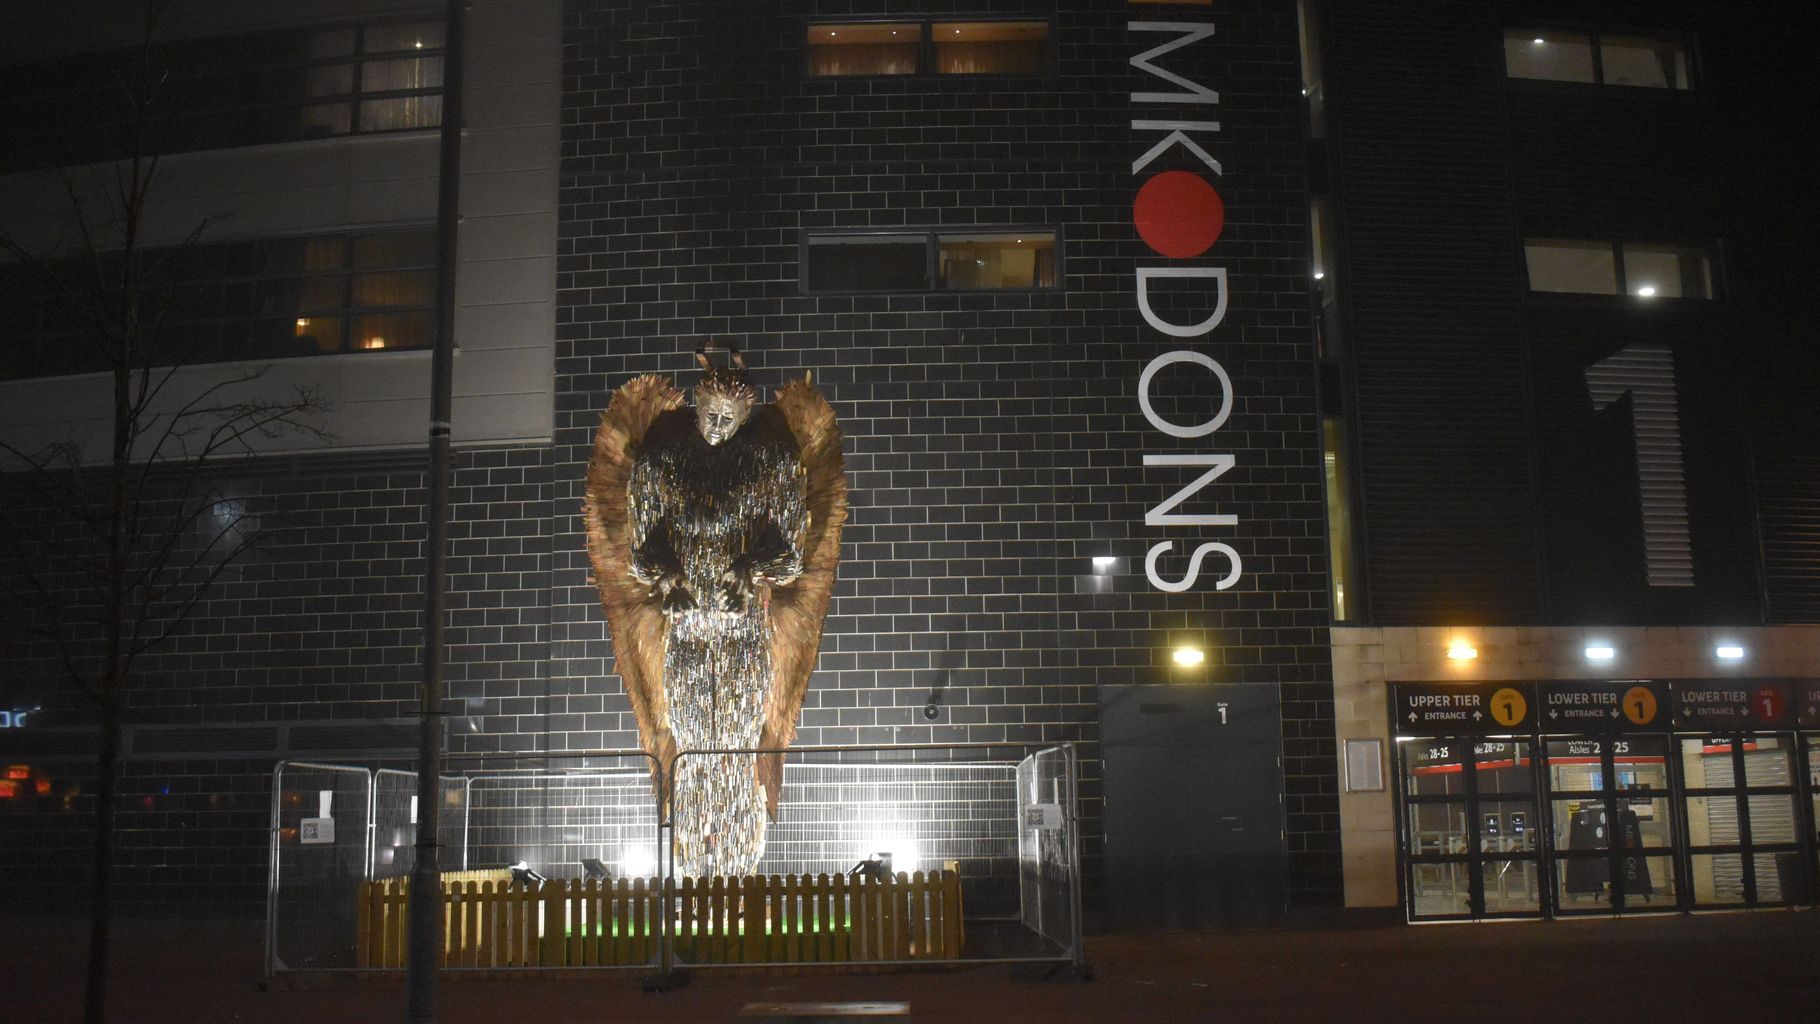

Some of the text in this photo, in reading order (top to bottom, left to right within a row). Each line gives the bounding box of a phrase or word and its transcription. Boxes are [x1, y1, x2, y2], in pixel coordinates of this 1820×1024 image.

[1127, 21, 1243, 593] MK DONS
[1583, 343, 1696, 587] 1
[1409, 694, 1481, 707] UPPER TIER
[1548, 693, 1588, 705] LOWER
[1591, 692, 1618, 704] TIER
[1681, 691, 1748, 703] LOWER TIER
[1503, 702, 1513, 721] 1
[1564, 709, 1605, 718] ENTRANCE
[1634, 700, 1645, 719] 1
[1697, 706, 1736, 716] ENTRANCE
[1762, 698, 1773, 717] 1
[1218, 707, 1226, 724] 1
[1424, 711, 1467, 720] ENTRANCE
